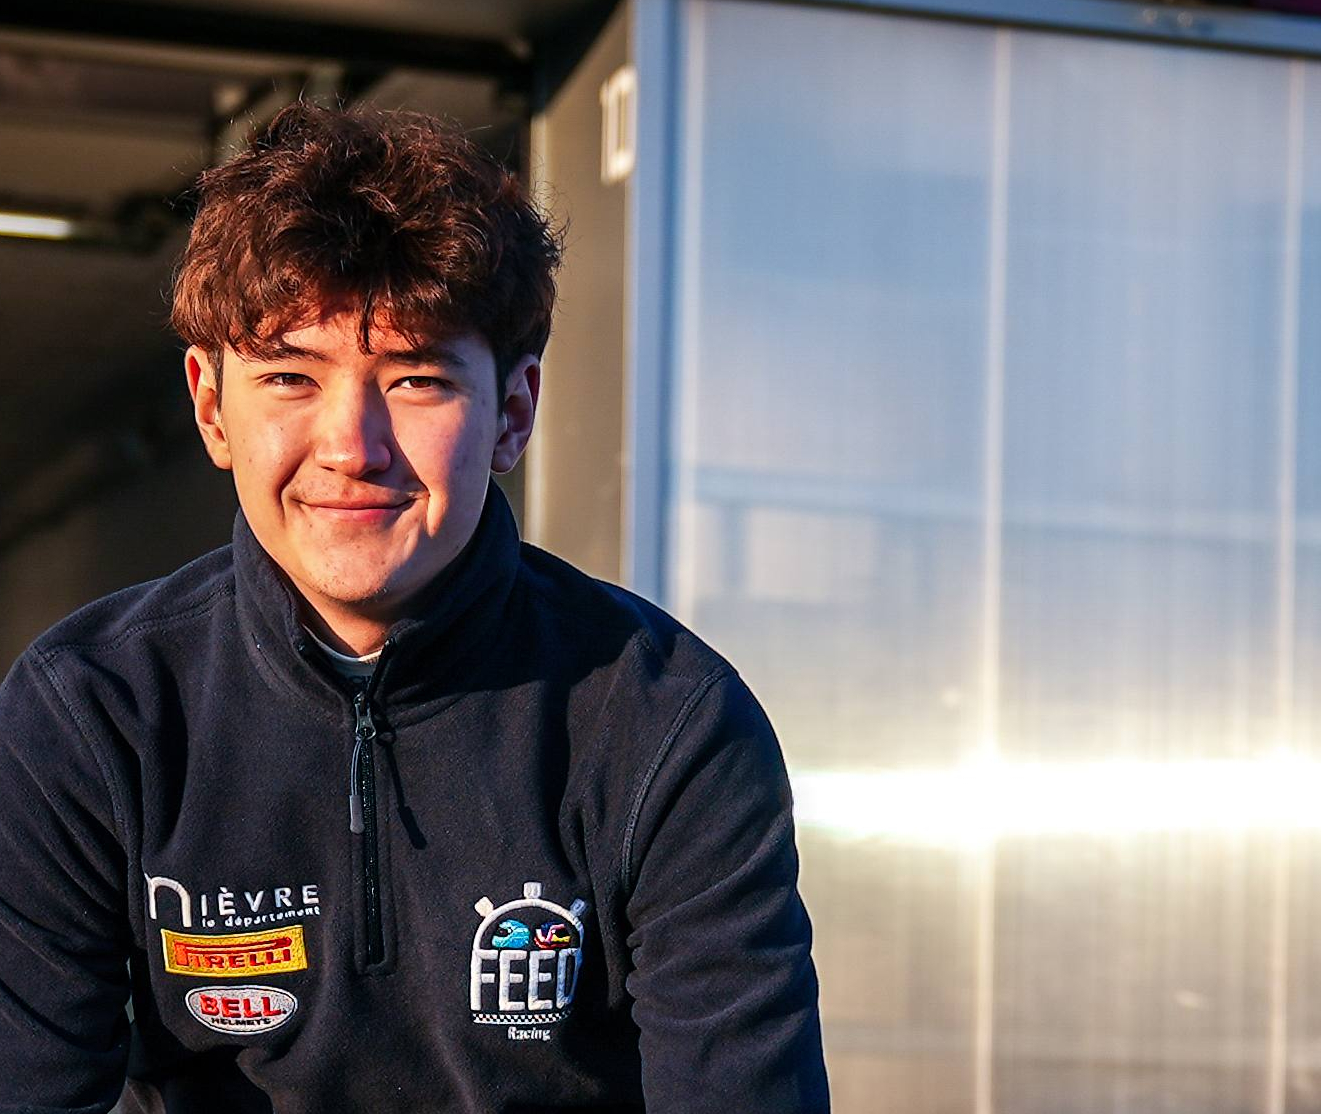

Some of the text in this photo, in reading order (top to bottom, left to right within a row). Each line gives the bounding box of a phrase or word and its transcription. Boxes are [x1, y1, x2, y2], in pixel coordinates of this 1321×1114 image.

[202, 918, 216, 927] le
[174, 937, 293, 968] PIRELLI
[469, 948, 583, 1011] FEED
[199, 993, 282, 1018] BELL
[211, 1017, 272, 1027] HELMETS
[507, 1026, 551, 1041] Racing
